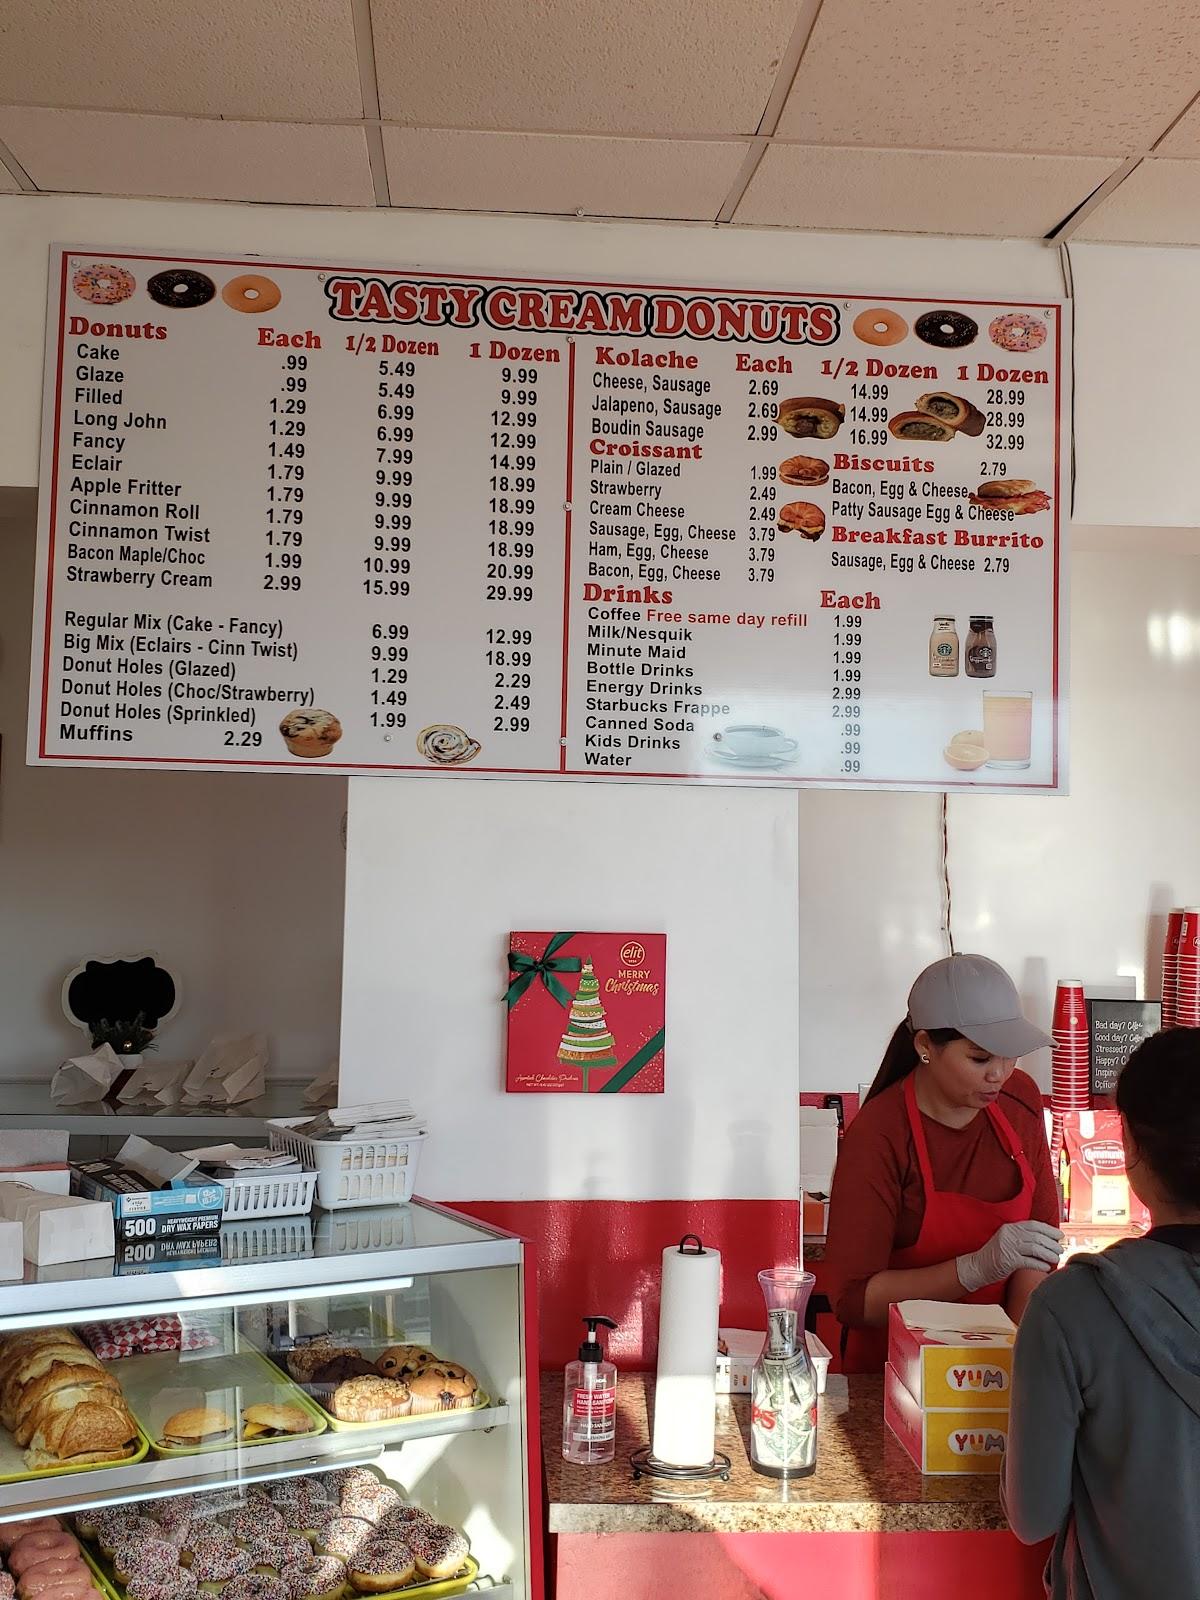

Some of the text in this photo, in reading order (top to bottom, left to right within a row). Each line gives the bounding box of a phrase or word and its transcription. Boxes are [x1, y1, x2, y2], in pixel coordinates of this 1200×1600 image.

[328, 279, 835, 343] TASTY CREAM DONUTS
[68, 316, 168, 340] Donuts
[257, 327, 322, 350] Each
[345, 332, 440, 356] 1/2 Dozen
[76, 343, 120, 361] Cake
[469, 340, 561, 363] 1 Dozen
[595, 346, 698, 370] Kolache
[281, 354, 308, 371] .99
[378, 360, 416, 377] 5.49
[735, 353, 793, 374] Each
[820, 357, 938, 380] 1/2 Dozen
[76, 365, 124, 383] Glaze
[501, 367, 538, 384] 9.99
[956, 363, 1049, 384] 1 Dozen
[592, 371, 711, 397] Cheese, Sausage
[748, 379, 779, 396] 2.69
[850, 383, 889, 401] 14.99
[74, 387, 123, 405] Filled
[986, 388, 1025, 408] 28.99
[591, 394, 722, 420] Jalapeno, Sausage
[74, 409, 167, 431] Long John
[592, 417, 704, 442] Boudin Sausage
[73, 431, 126, 454] Fancy
[589, 438, 703, 460] Croissant
[72, 453, 123, 472] Eclair
[590, 458, 681, 477] Plain Glazed
[833, 453, 935, 473] Biscuits
[980, 461, 1007, 476] 2.79
[750, 465, 777, 481] 1.99
[70, 476, 182, 497] Apple Fritter
[590, 479, 662, 501] Strawberry
[832, 478, 876, 498] Bacon,
[880, 480, 904, 500] Egg
[908, 480, 918, 497] &
[70, 498, 200, 520] Cinnamon Roll
[590, 499, 685, 518] Cream Cheese
[832, 500, 1014, 524] Patty Sausage Egg & Cheese
[69, 520, 210, 543] Cinnamon Twist
[589, 520, 736, 542] Sausage, Egg, Cheese
[831, 526, 1044, 549] Breakfast Burrito
[68, 543, 206, 566] Bacon Maple/Choc
[588, 540, 709, 562] Ham, Egg, Cheese
[588, 561, 721, 582] Bacon, Egg, Cheese
[831, 551, 1010, 573] Sausage, Egg & Cheese 2.79
[66, 565, 212, 589] Strawberry Cream
[263, 574, 301, 592] 2.99
[363, 579, 410, 596] 15.99
[486, 584, 533, 602] 29.99
[582, 582, 673, 604] Drinks
[820, 590, 881, 610] Each
[64, 610, 283, 640] Regular Mix (Cake Fancy)
[588, 606, 807, 629] Coffee Free same day refill
[834, 614, 862, 628] 1.99
[588, 624, 692, 644] Milk/Nesquik
[64, 633, 298, 662] Big Mix (Eclairs Cinn Twist)
[587, 642, 686, 659] Minute Maid
[62, 655, 236, 682] Donut Holes (Glazed)
[587, 661, 694, 678] Bottle Drinks
[61, 678, 314, 707] Donut Holes (Choc/Strawberry)
[586, 679, 703, 698] Energy Drinks
[60, 700, 256, 728] Donut Holes (Sprinkled)
[585, 697, 730, 718] Starbucks Frappe
[370, 711, 406, 728] 1.99
[493, 716, 530, 732] 2.99
[585, 715, 695, 732] Canned Soda
[60, 723, 133, 742] Muffins
[223, 730, 262, 747] 2.29
[585, 733, 680, 750] Kids Drinks
[584, 752, 632, 766] Water
[623, 946, 642, 958] elit
[618, 969, 650, 979] MERRY
[605, 978, 659, 995] Christmas
[125, 1218, 219, 1237] 500 DRY WAX PAPERS
[953, 1369, 1003, 1389] YUM
[955, 1433, 1005, 1452] YUM
